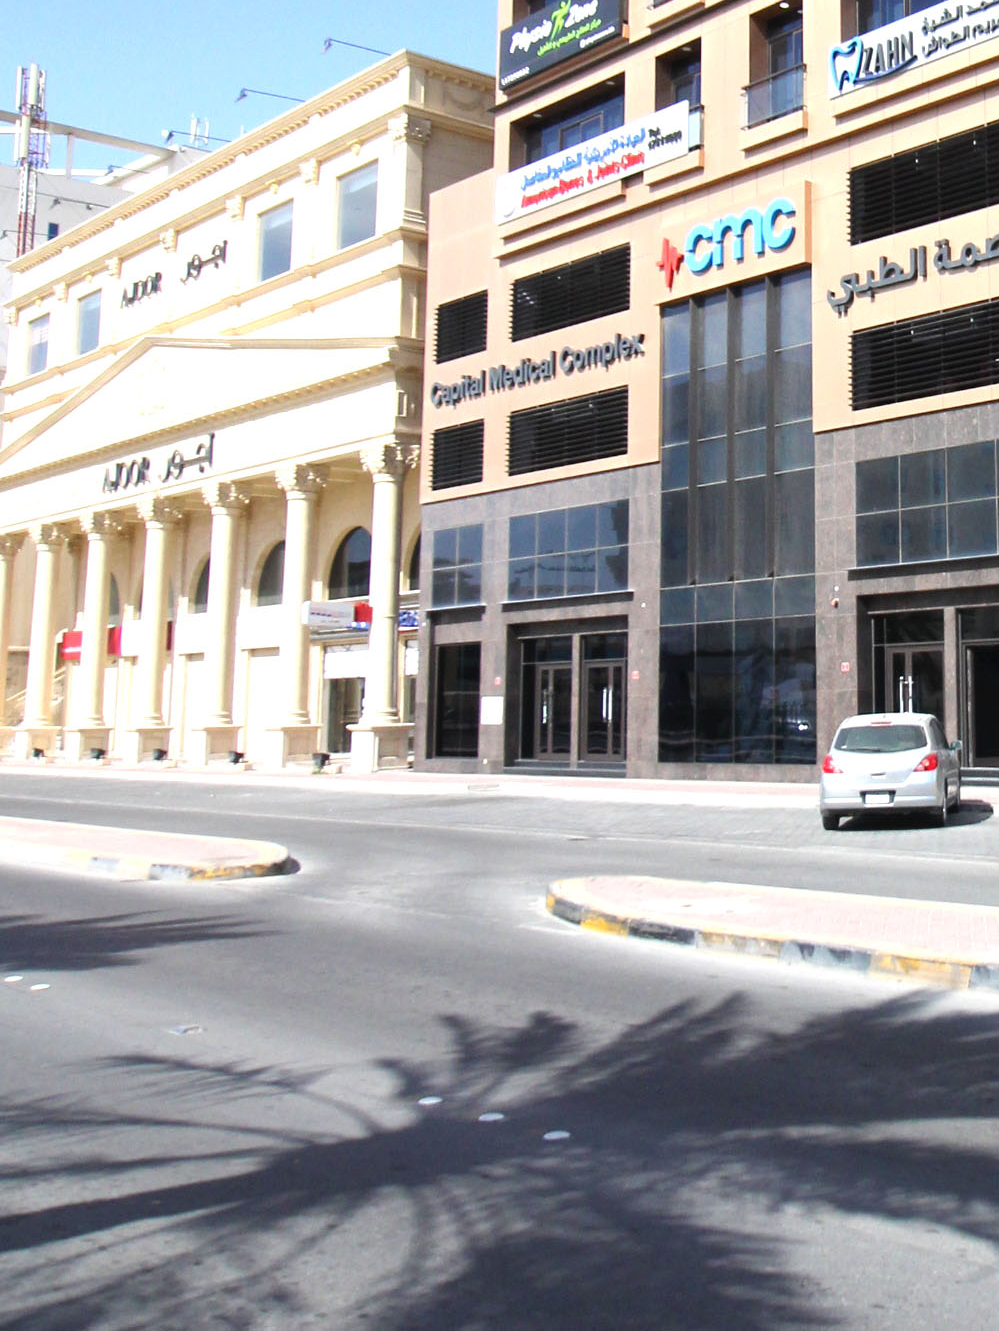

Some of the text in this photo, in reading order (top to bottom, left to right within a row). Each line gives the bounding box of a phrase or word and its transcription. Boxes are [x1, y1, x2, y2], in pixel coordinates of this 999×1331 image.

[862, 30, 915, 76] ZAHN
[684, 197, 796, 276] cmc
[826, 244, 928, 318] الطبي
[430, 332, 646, 409] Capital Medical Complex
